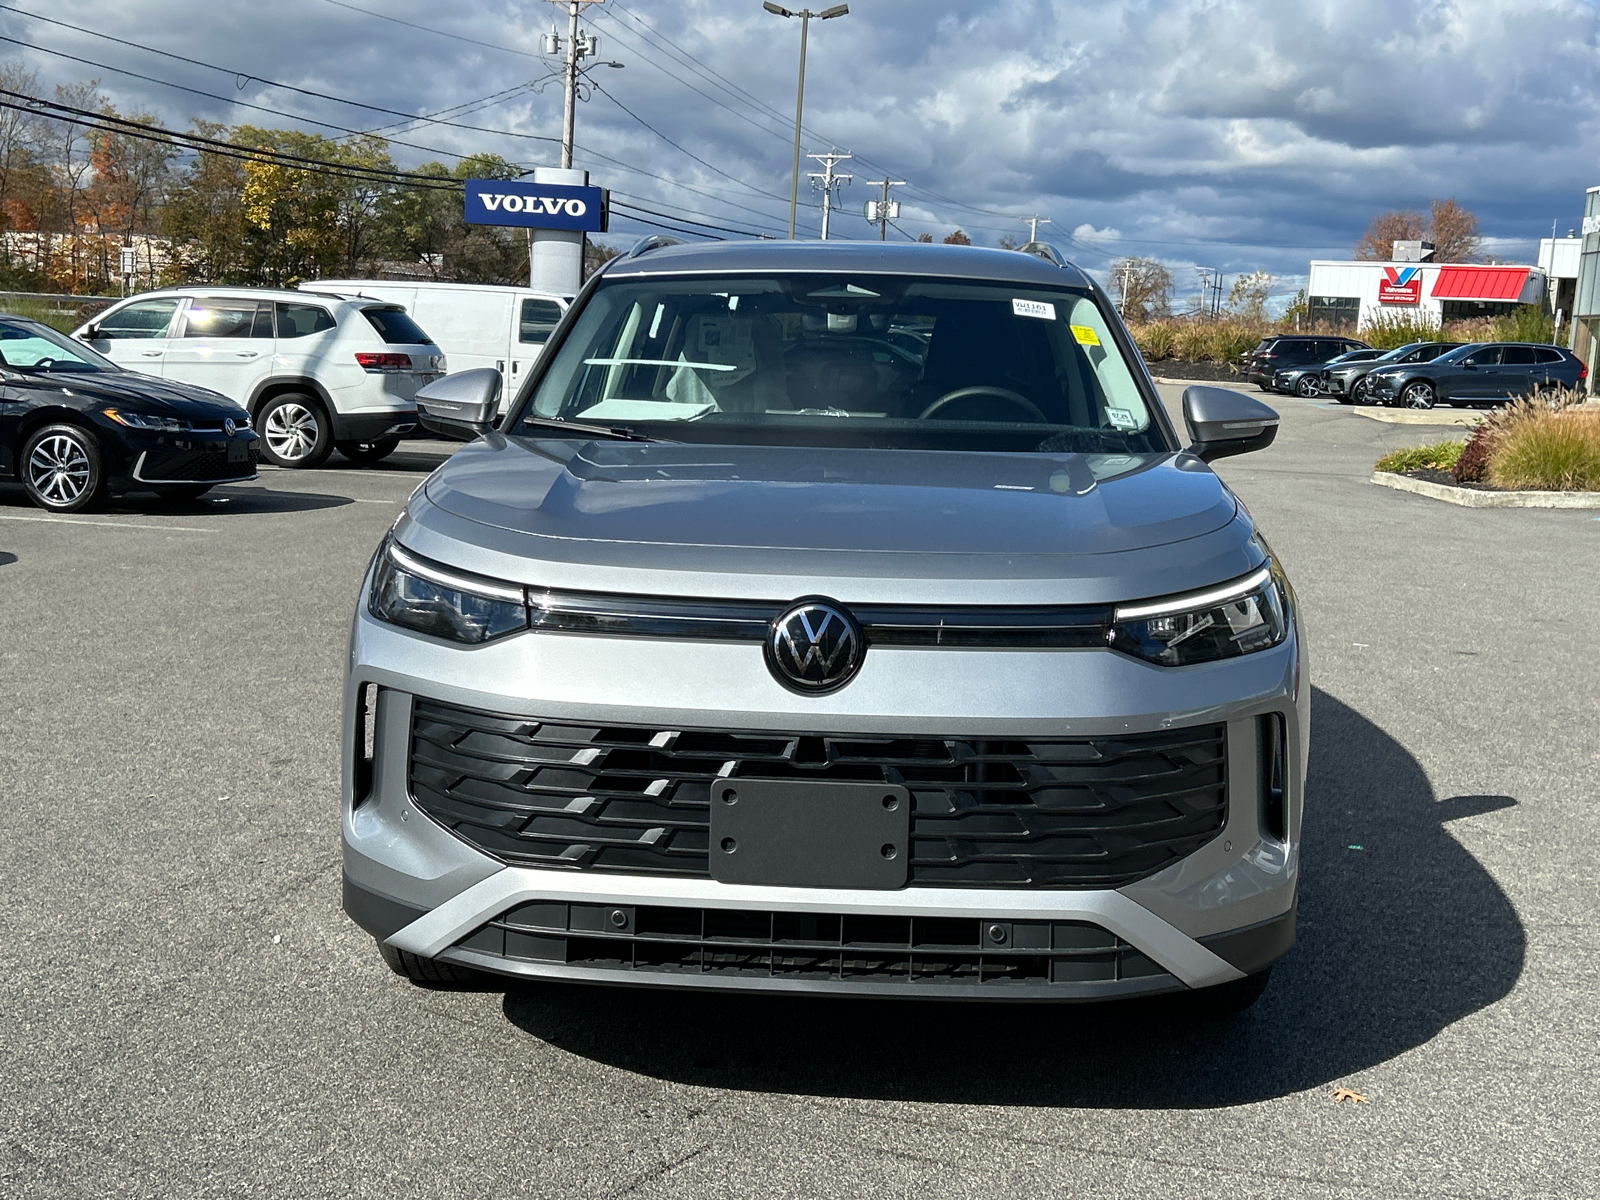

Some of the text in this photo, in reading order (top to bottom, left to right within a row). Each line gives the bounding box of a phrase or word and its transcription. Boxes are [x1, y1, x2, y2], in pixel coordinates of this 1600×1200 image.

[478, 193, 586, 217] VOLVO
[1015, 302, 1047, 311] VW1161
[776, 604, 856, 682] VW
